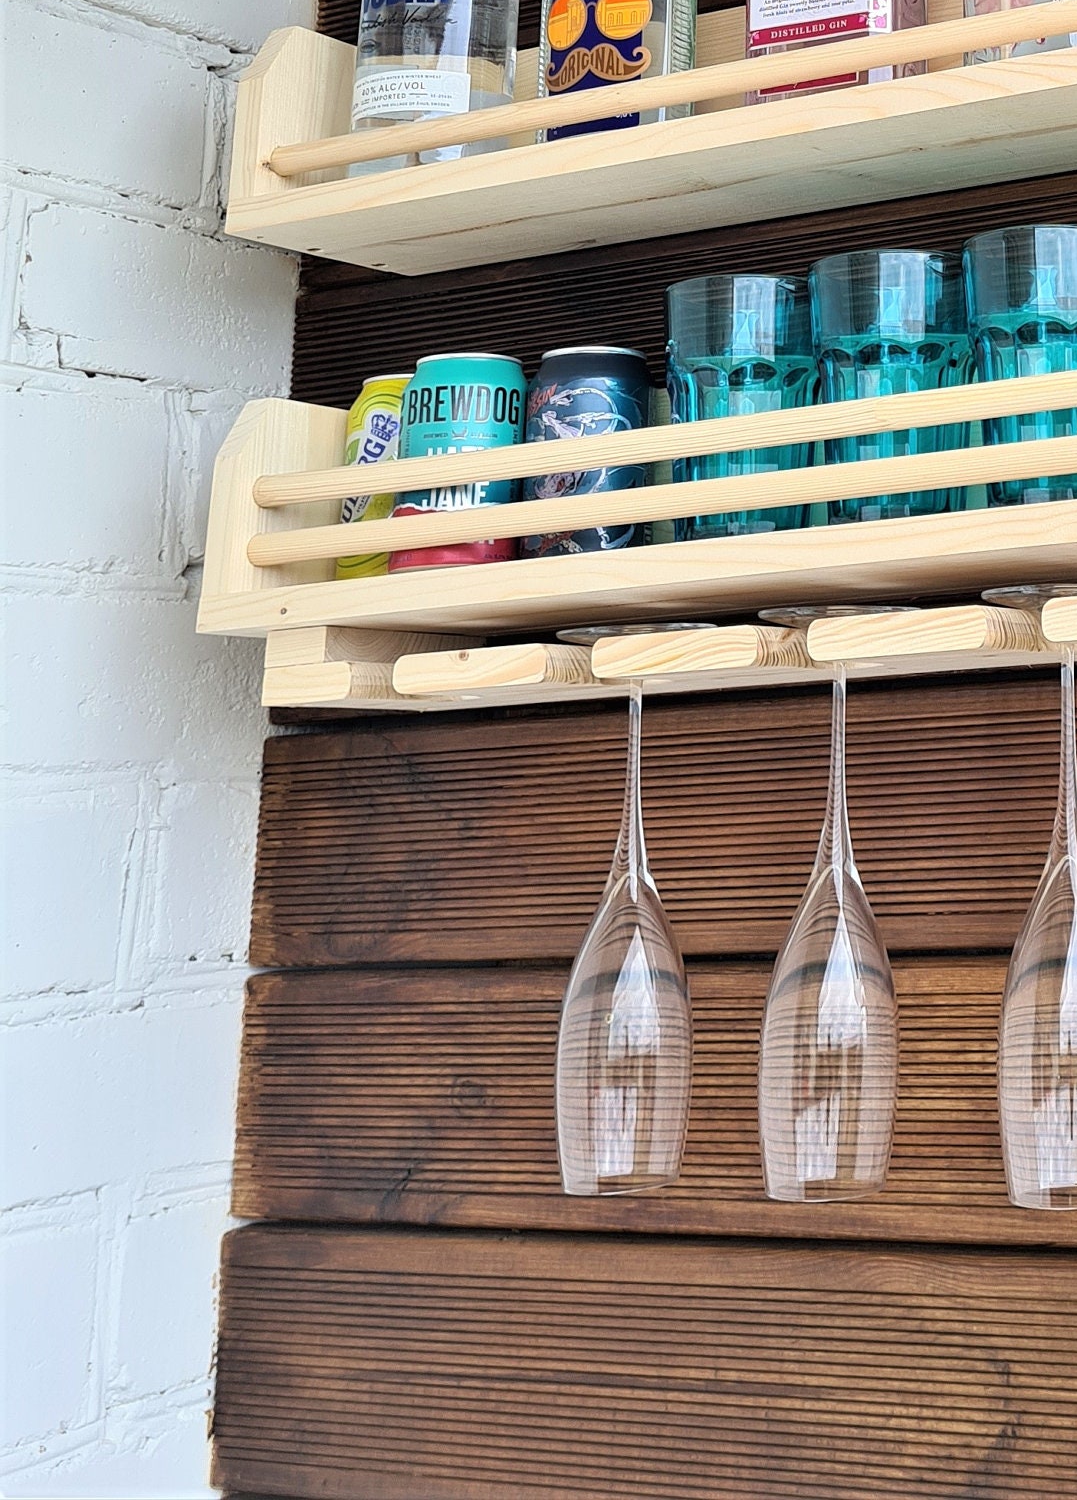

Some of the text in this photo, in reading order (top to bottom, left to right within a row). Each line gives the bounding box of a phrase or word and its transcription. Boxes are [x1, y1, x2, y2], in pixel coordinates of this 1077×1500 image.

[770, 19, 848, 39] DISTILLED GIN
[560, 46, 624, 86] ORIGINAL
[371, 92, 407, 103] IMPORTED
[378, 81, 427, 93] ALC/VOL
[407, 385, 521, 427] BREWDOG
[421, 481, 490, 511] JANE
